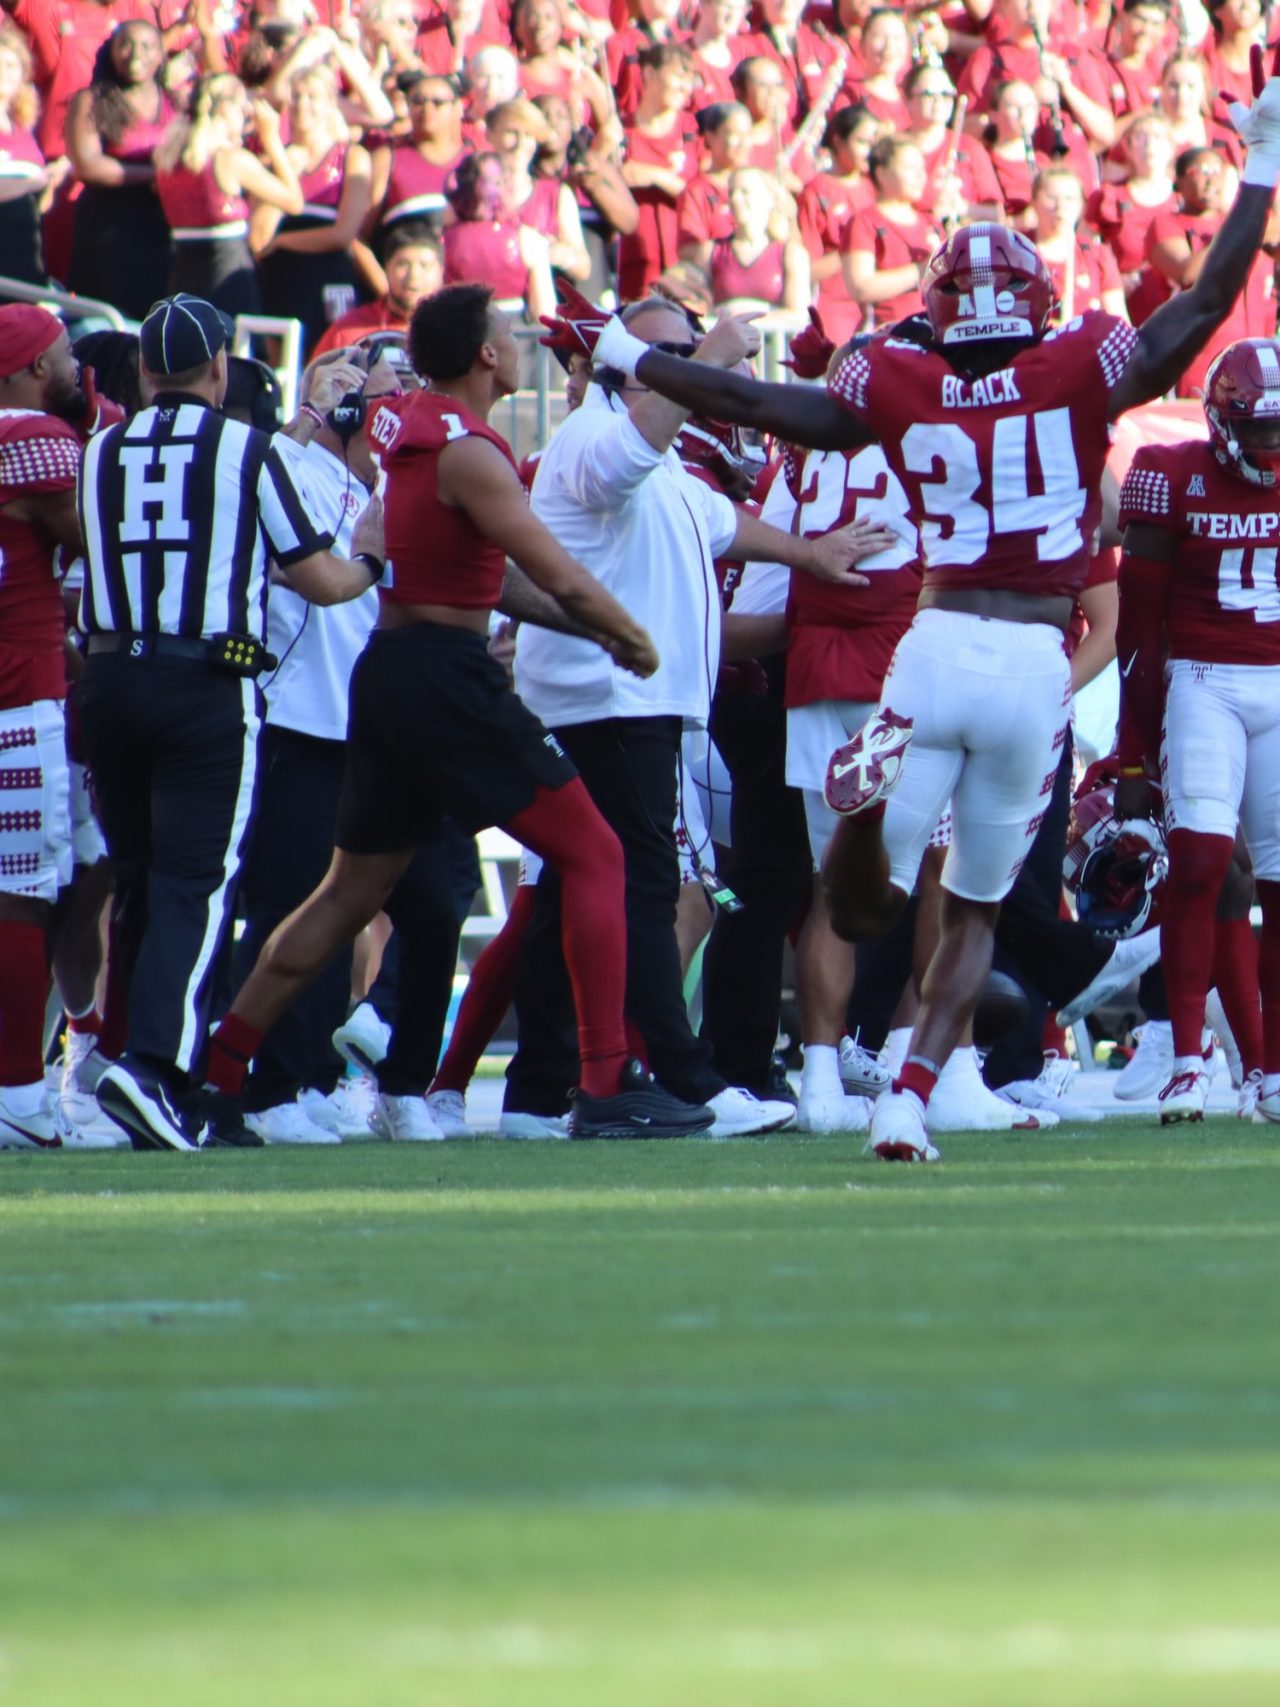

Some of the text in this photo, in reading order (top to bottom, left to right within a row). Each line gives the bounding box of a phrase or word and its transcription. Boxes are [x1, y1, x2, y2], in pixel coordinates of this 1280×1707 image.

[954, 321, 1020, 338] TEMPLE
[942, 367, 1021, 407] BLACK
[441, 414, 469, 440] 1
[118, 444, 195, 542] H
[901, 406, 1087, 568] 34
[130, 639, 145, 657] S
